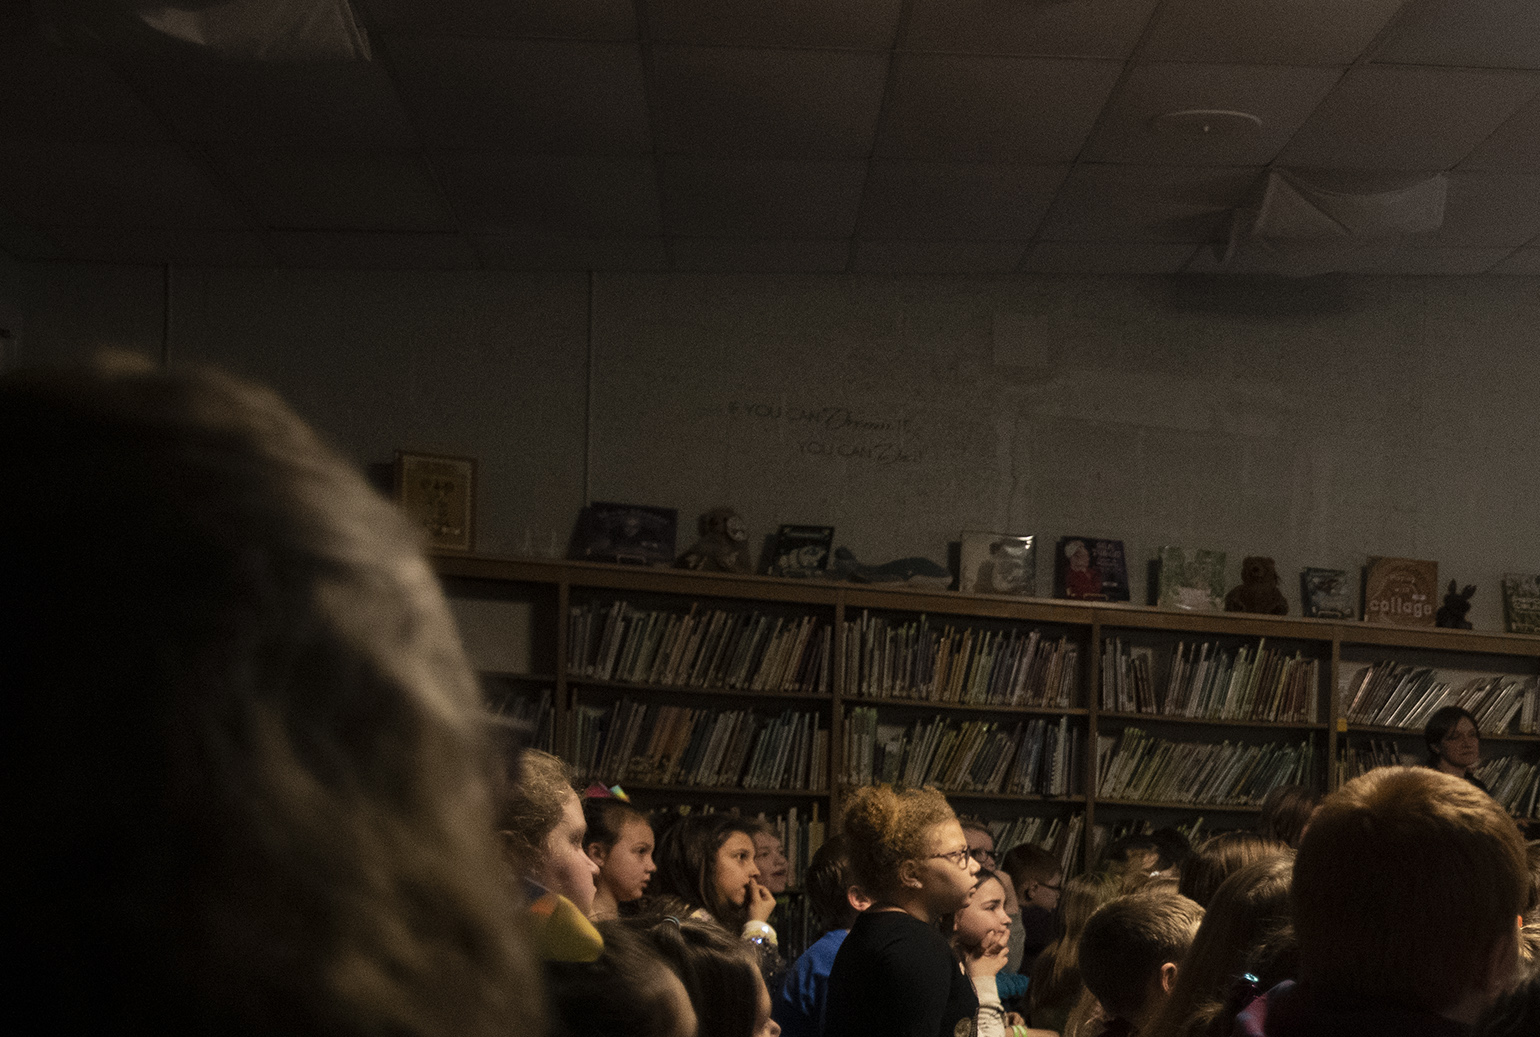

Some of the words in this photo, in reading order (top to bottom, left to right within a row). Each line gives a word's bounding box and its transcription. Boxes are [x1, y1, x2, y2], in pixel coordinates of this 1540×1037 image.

[745, 402, 782, 419] YOU
[786, 407, 821, 423] CAN
[799, 441, 833, 456] YOU
[838, 445, 872, 459] CAN
[1369, 597, 1433, 618] collage
